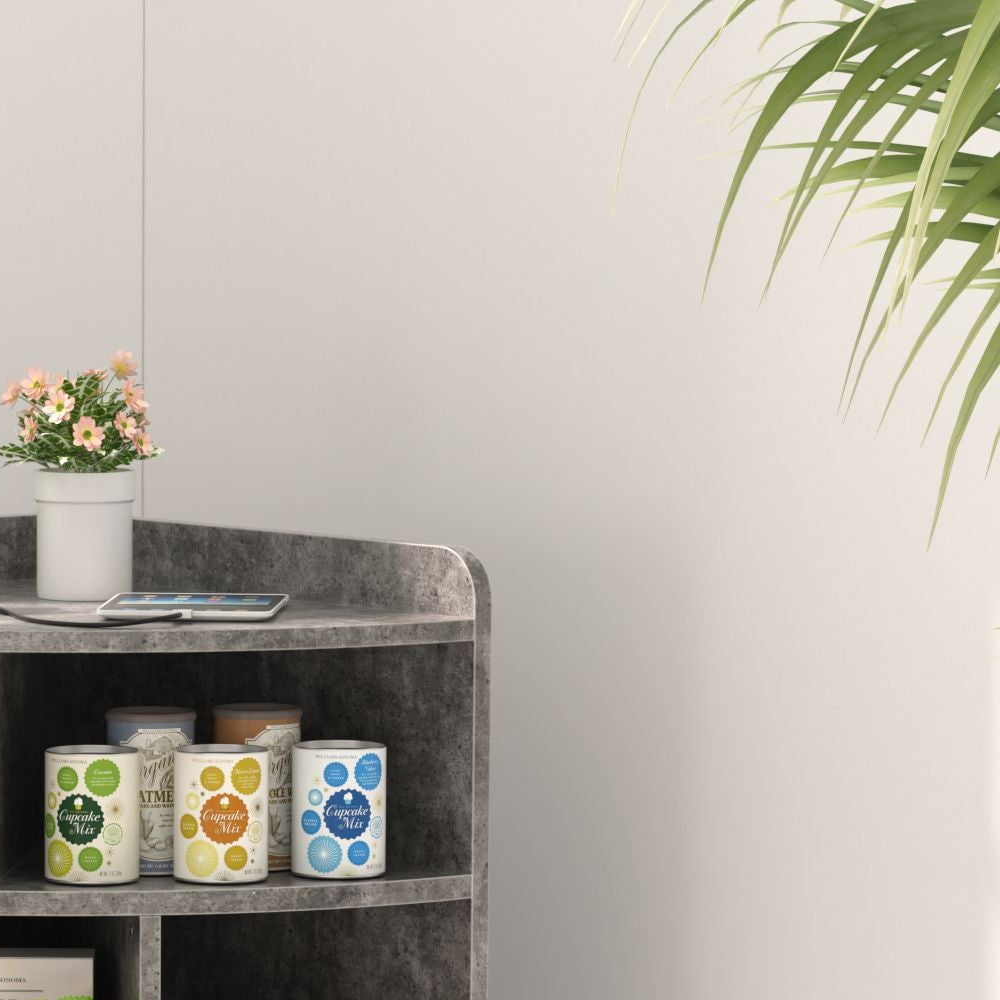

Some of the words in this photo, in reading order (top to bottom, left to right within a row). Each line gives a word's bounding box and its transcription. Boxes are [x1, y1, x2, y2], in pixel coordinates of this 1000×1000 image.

[59, 809, 101, 825] Cupcake
[203, 809, 246, 824] Cupcake
[326, 805, 368, 819] Cupcake
[70, 822, 96, 835] Mix
[215, 821, 241, 834] Mix
[338, 817, 364, 829] Mix
